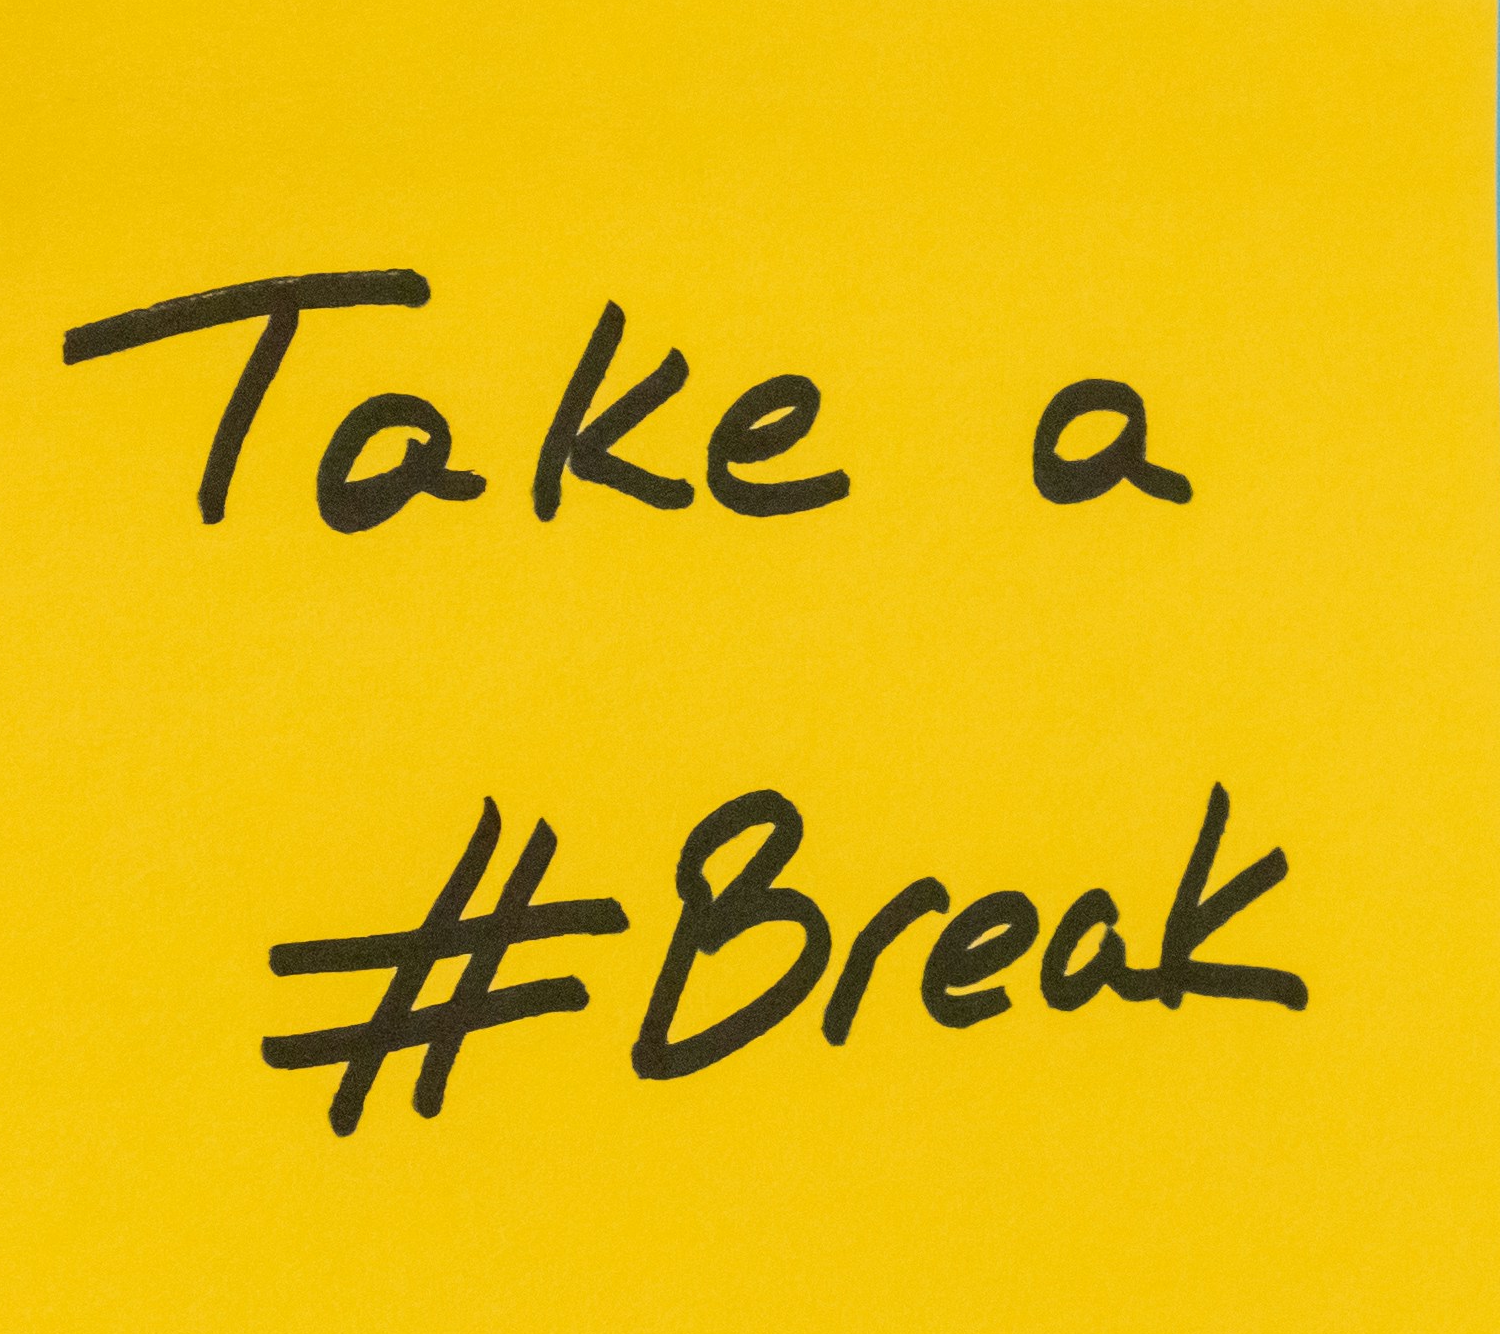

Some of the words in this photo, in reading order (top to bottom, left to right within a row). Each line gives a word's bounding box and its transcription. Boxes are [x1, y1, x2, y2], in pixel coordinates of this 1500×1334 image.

[62, 268, 851, 535] Take
[1032, 378, 1193, 506] a
[261, 781, 1309, 1138] #Break
